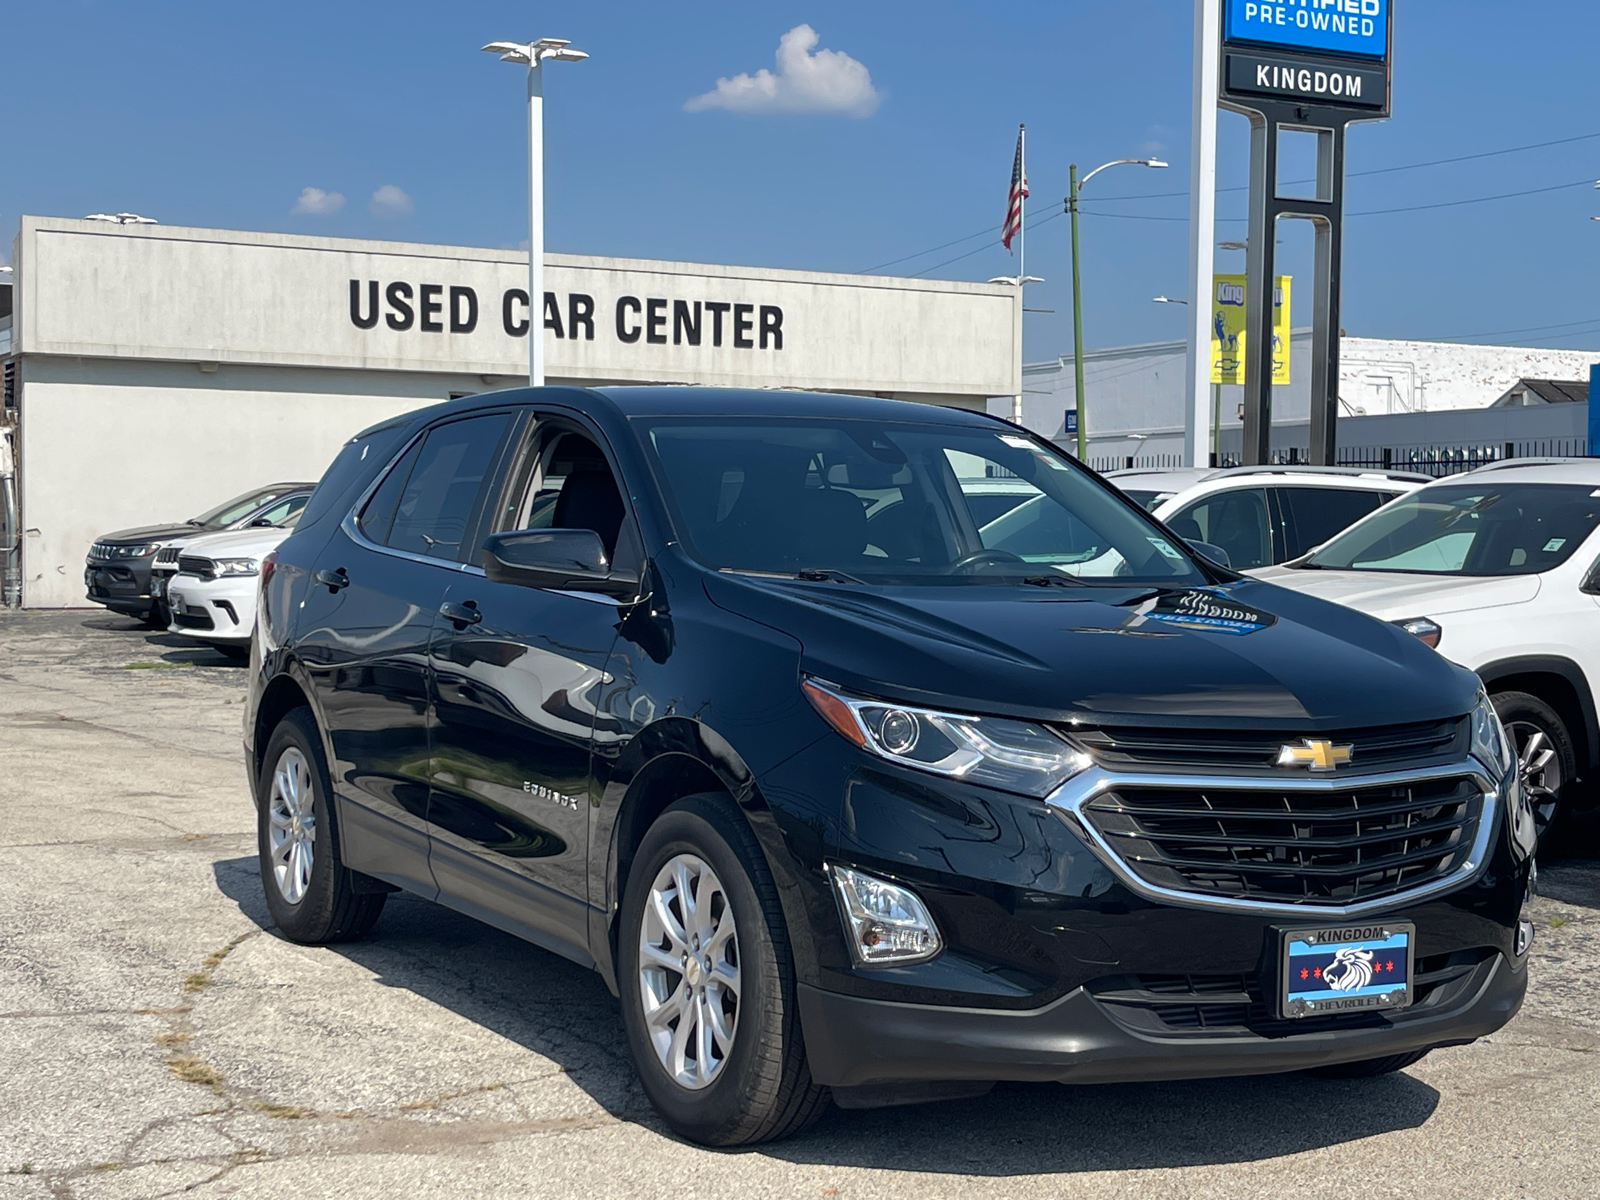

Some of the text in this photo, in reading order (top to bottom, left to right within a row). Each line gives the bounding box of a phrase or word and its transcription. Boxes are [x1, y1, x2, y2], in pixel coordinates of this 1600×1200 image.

[1245, 3, 1374, 36] PRE-OWNED
[1256, 64, 1362, 97] KINGDOM
[349, 279, 785, 350] USED CAR CENTER
[523, 780, 578, 811] EQUINOX
[1317, 927, 1385, 943] KINGDOM
